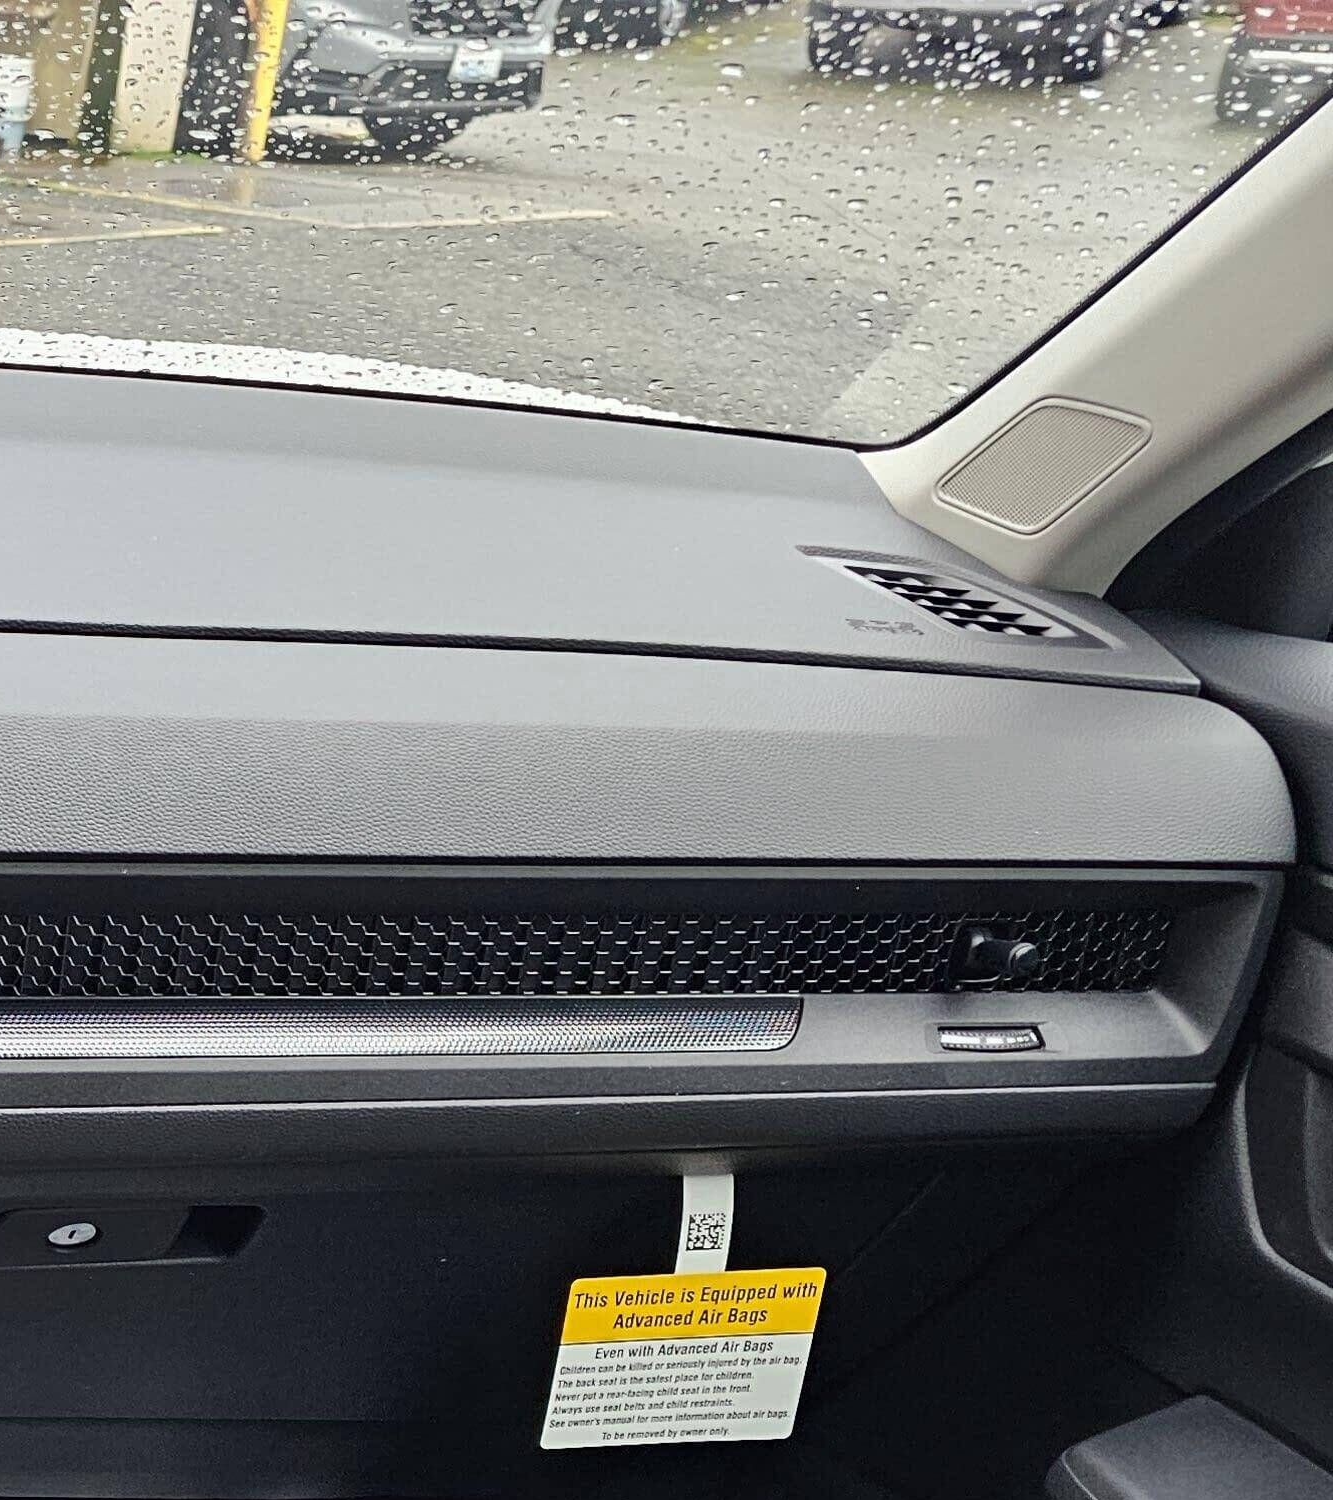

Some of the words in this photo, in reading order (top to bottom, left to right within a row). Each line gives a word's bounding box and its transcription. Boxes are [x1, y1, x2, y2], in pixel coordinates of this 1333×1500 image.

[575, 1292, 608, 1309] This
[615, 1289, 674, 1307] Vehicle
[681, 1288, 695, 1303] is
[700, 1284, 777, 1305] Equipped
[783, 1282, 817, 1298] with
[613, 1310, 694, 1329] Advanced
[698, 1309, 723, 1325] Air
[728, 1308, 768, 1325] Bags
[595, 1348, 624, 1359] Even
[628, 1345, 653, 1357] with
[657, 1342, 718, 1356] Advanced
[721, 1341, 740, 1353] Air
[743, 1340, 774, 1353] Bags
[560, 1365, 596, 1375] Children
[629, 1362, 653, 1371] killed
[666, 1360, 706, 1370] seriously
[707, 1358, 738, 1368] injured
[753, 1358, 767, 1366] the
[769, 1356, 781, 1364] air
[558, 1380, 573, 1389] The
[576, 1378, 595, 1388] back
[599, 1377, 617, 1386] seat
[630, 1376, 644, 1384] the
[646, 1375, 673, 1384] safest
[674, 1373, 698, 1383] place
[701, 1373, 714, 1381] for
[555, 1393, 580, 1402] Never
[583, 1392, 597, 1401] put
[607, 1389, 654, 1399] rear-facing
[657, 1387, 678, 1396] child
[680, 1386, 700, 1395] seat
[713, 1385, 727, 1393] the
[552, 1406, 582, 1415] Always
[603, 1404, 622, 1412] seat
[624, 1402, 645, 1411] belts
[648, 1401, 664, 1409] and
[666, 1400, 687, 1409] child
[549, 1420, 565, 1428] See
[568, 1418, 600, 1427] owner's
[602, 1416, 635, 1425] manual
[637, 1415, 649, 1423] for
[675, 1412, 724, 1421] information
[726, 1411, 751, 1420] about
[753, 1410, 765, 1418] air
[627, 1430, 665, 1439] removed
[679, 1428, 707, 1436] owner
